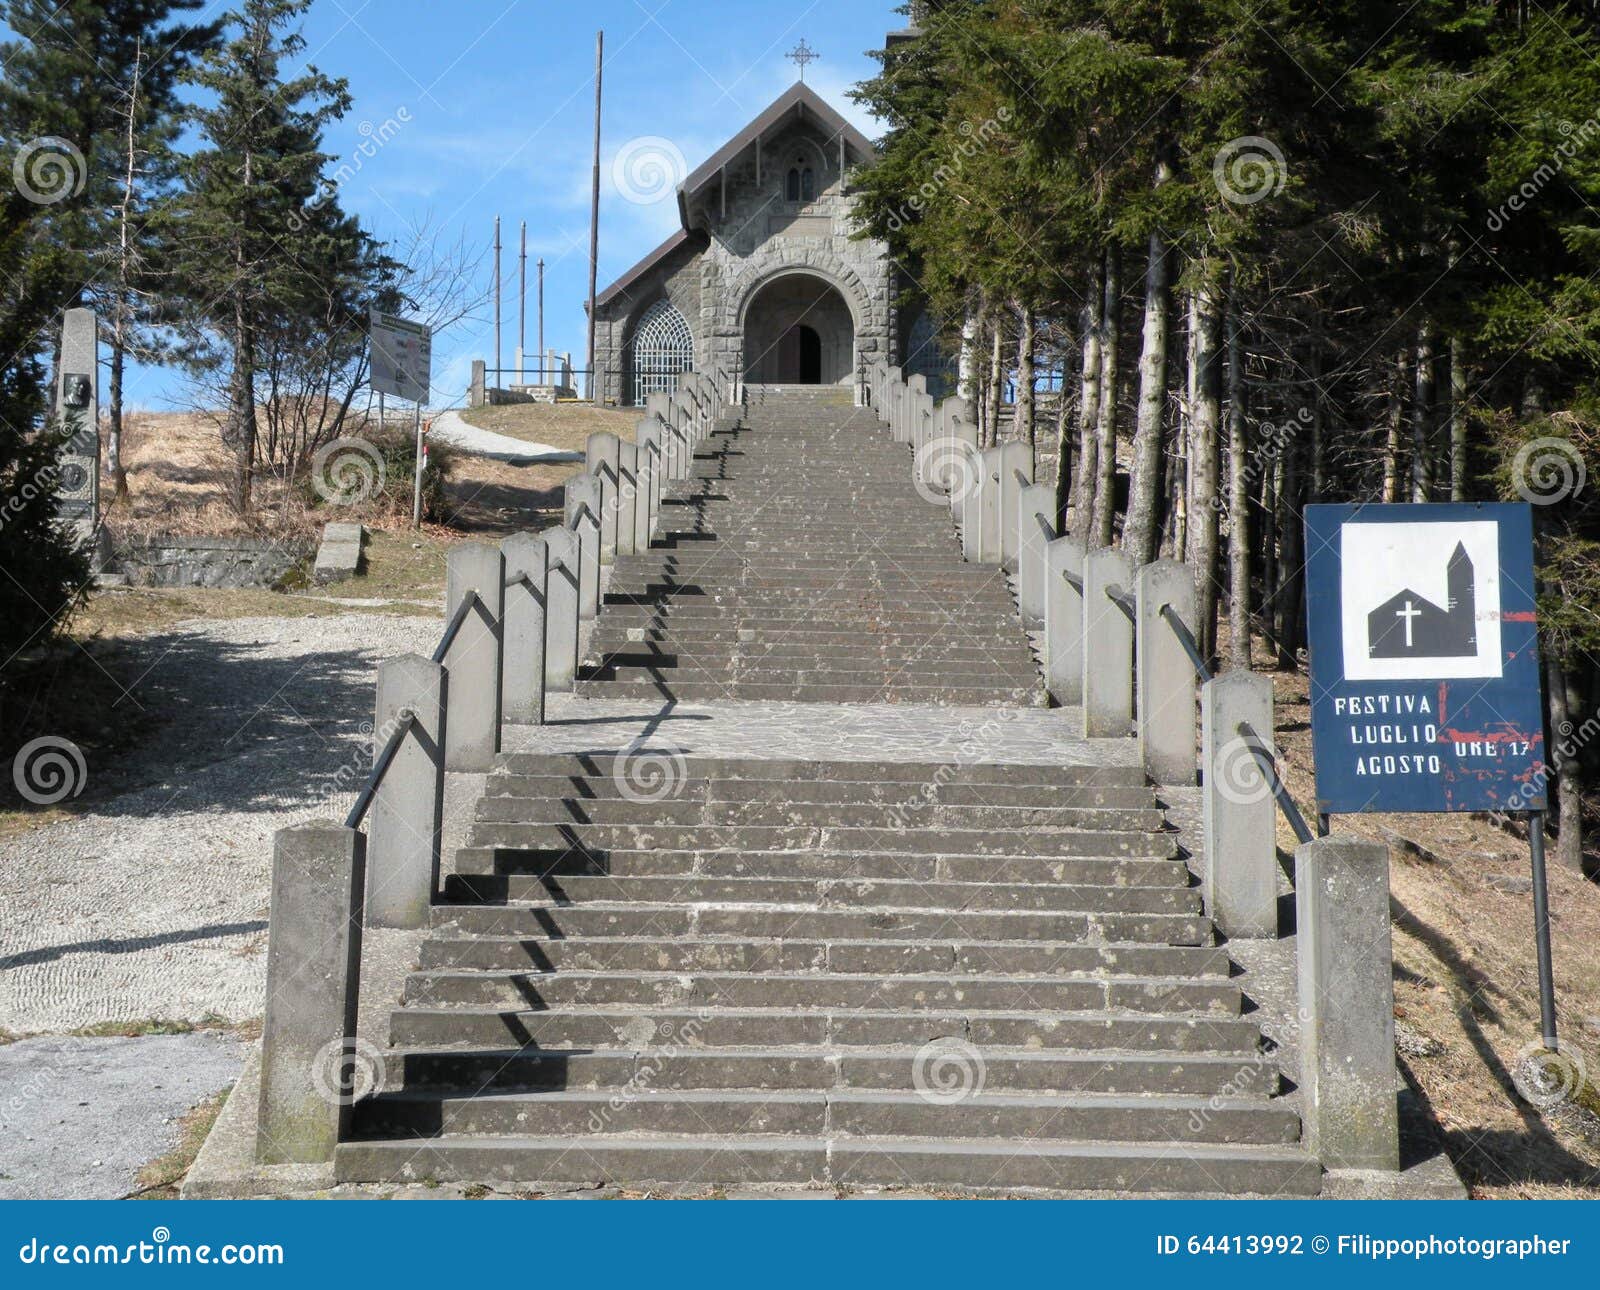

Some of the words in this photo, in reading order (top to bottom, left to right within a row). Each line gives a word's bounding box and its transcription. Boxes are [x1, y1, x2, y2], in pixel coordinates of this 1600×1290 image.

[1334, 695, 1431, 716] FESTIVA
[1350, 724, 1437, 744] LUGLIO
[1508, 741, 1530, 756] 17
[1356, 755, 1440, 775] AGOSTO
